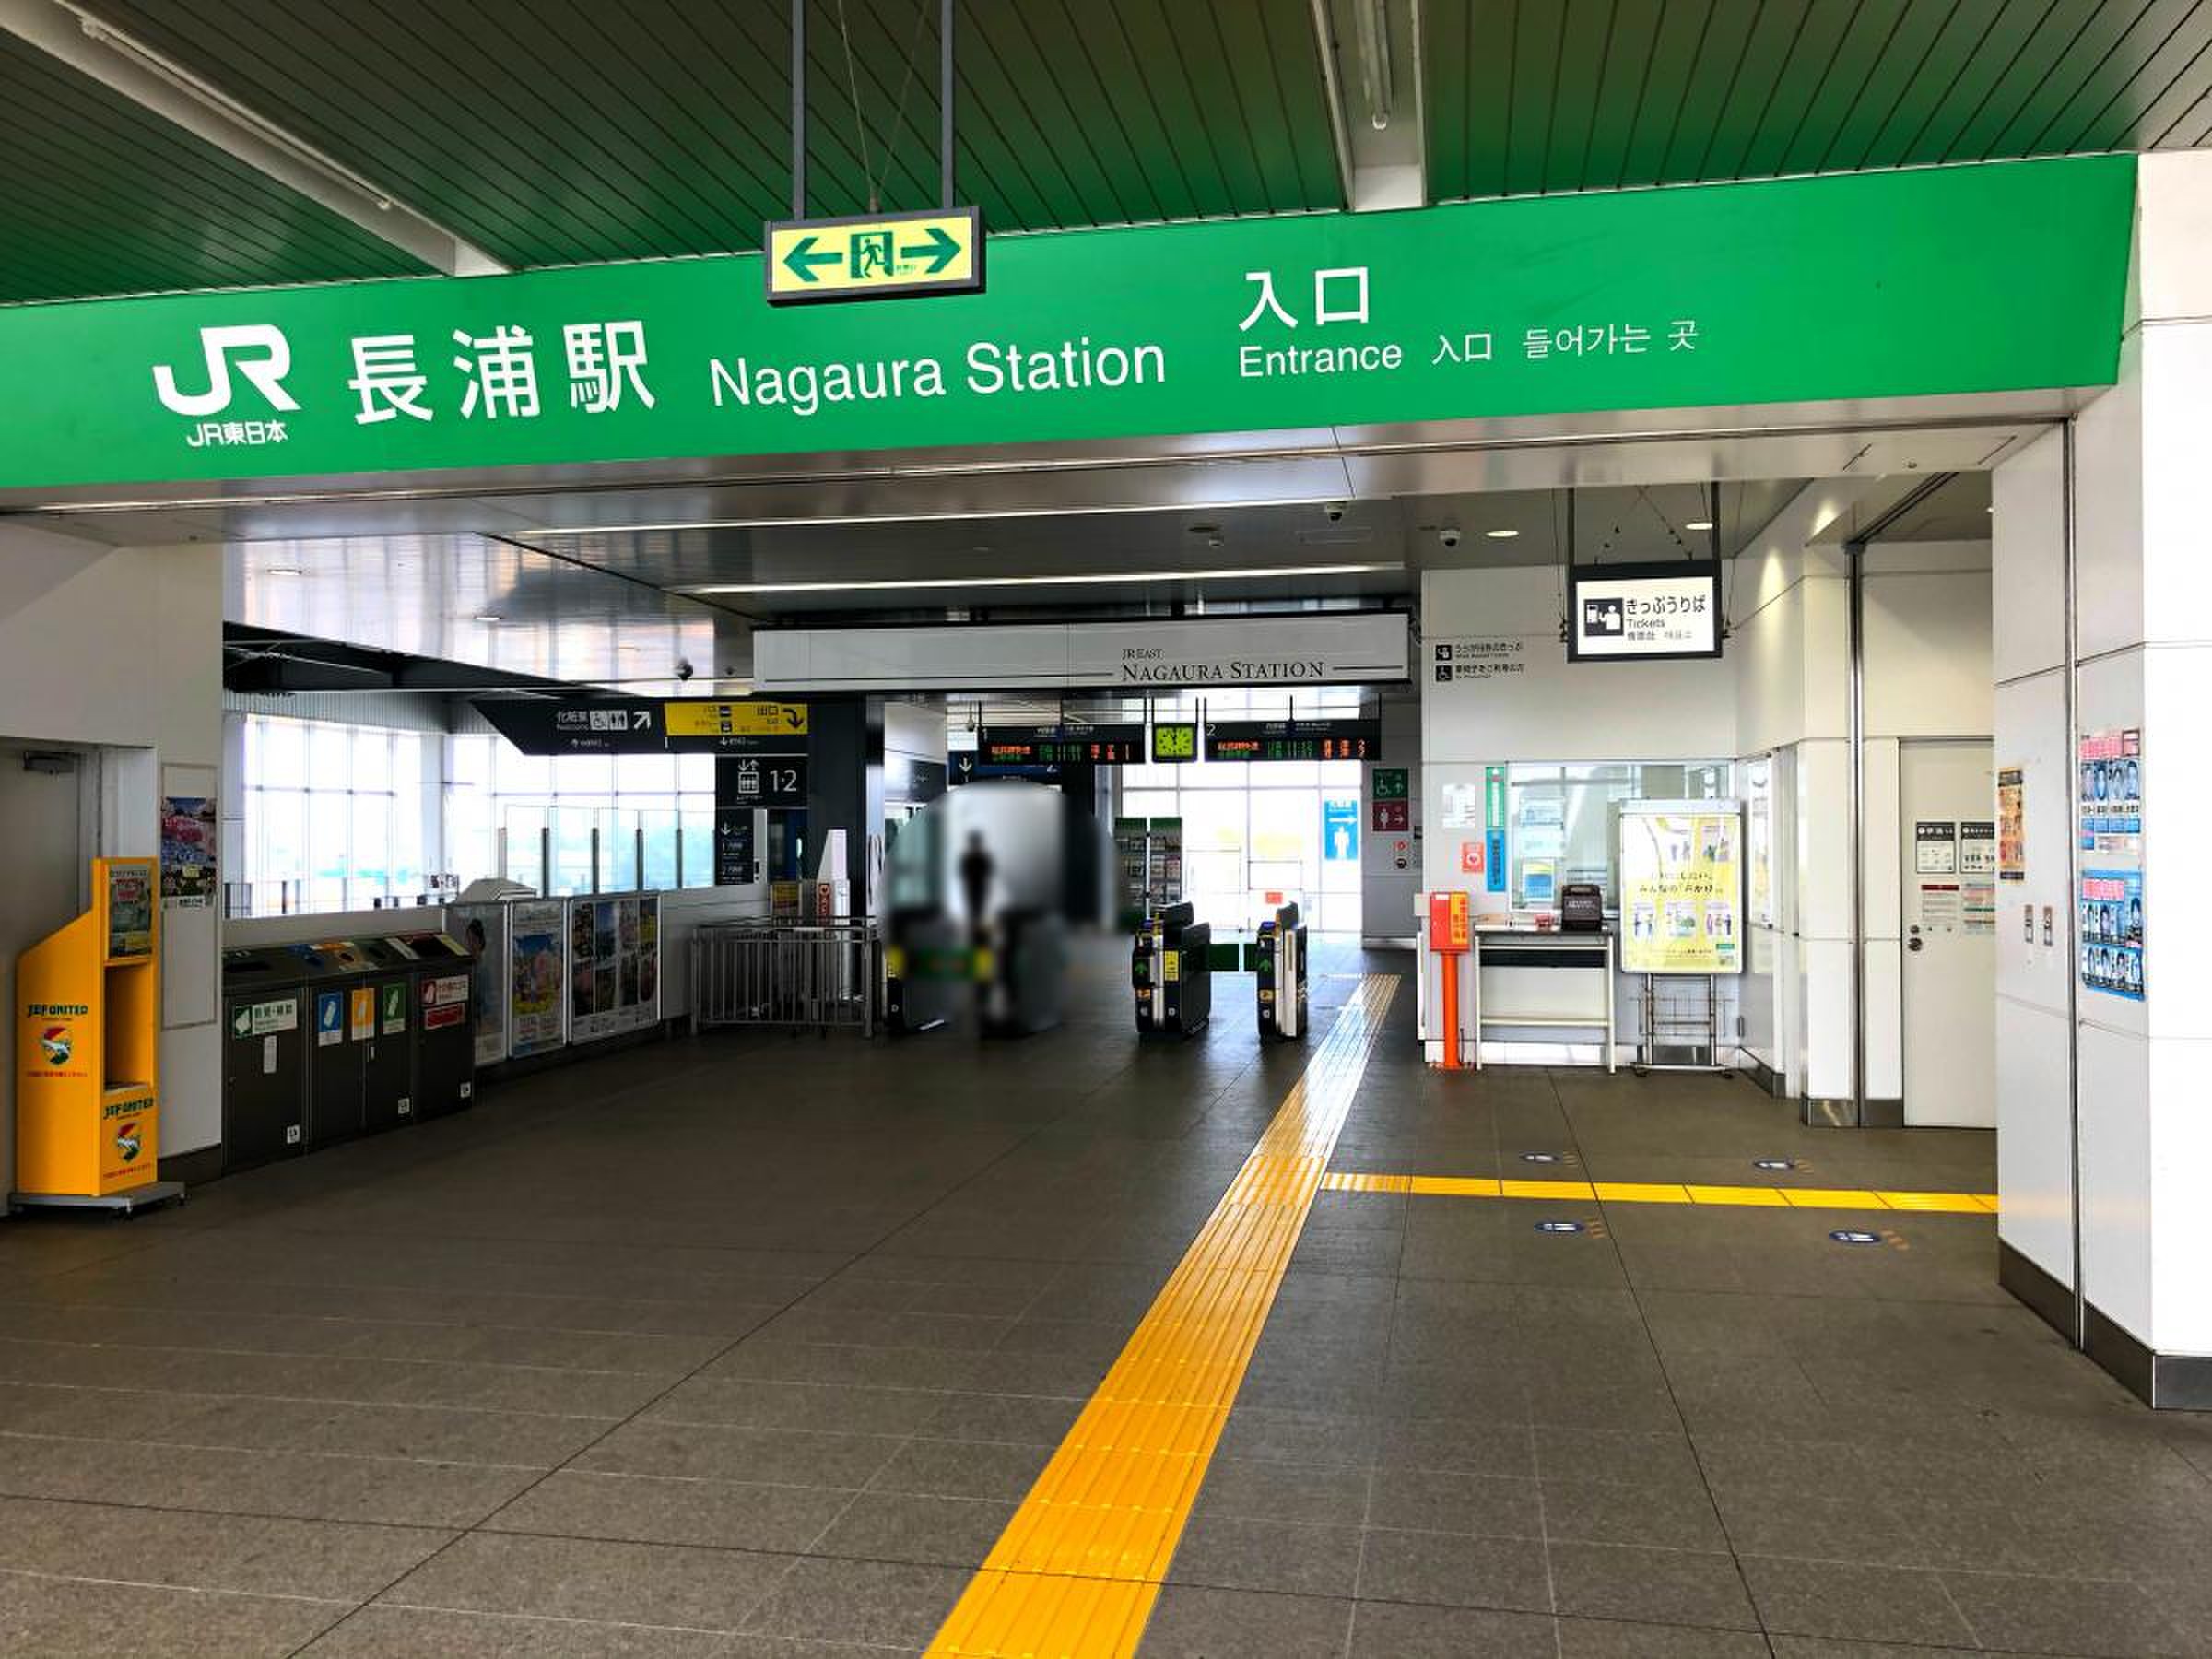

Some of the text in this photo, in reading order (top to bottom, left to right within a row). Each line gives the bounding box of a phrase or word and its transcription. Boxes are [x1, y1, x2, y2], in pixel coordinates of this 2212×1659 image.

[1239, 265, 1370, 332] 入口
[1240, 319, 1698, 377] Entrance 入口 들어가는 곳
[152, 324, 302, 416] JR
[348, 320, 1166, 425] 長浦駅 Nagaura Station
[187, 420, 288, 447] JR東日本
[1626, 594, 1706, 615] きっぷうりば
[1626, 618, 1665, 629] Tickets
[1206, 724, 1216, 736] 2
